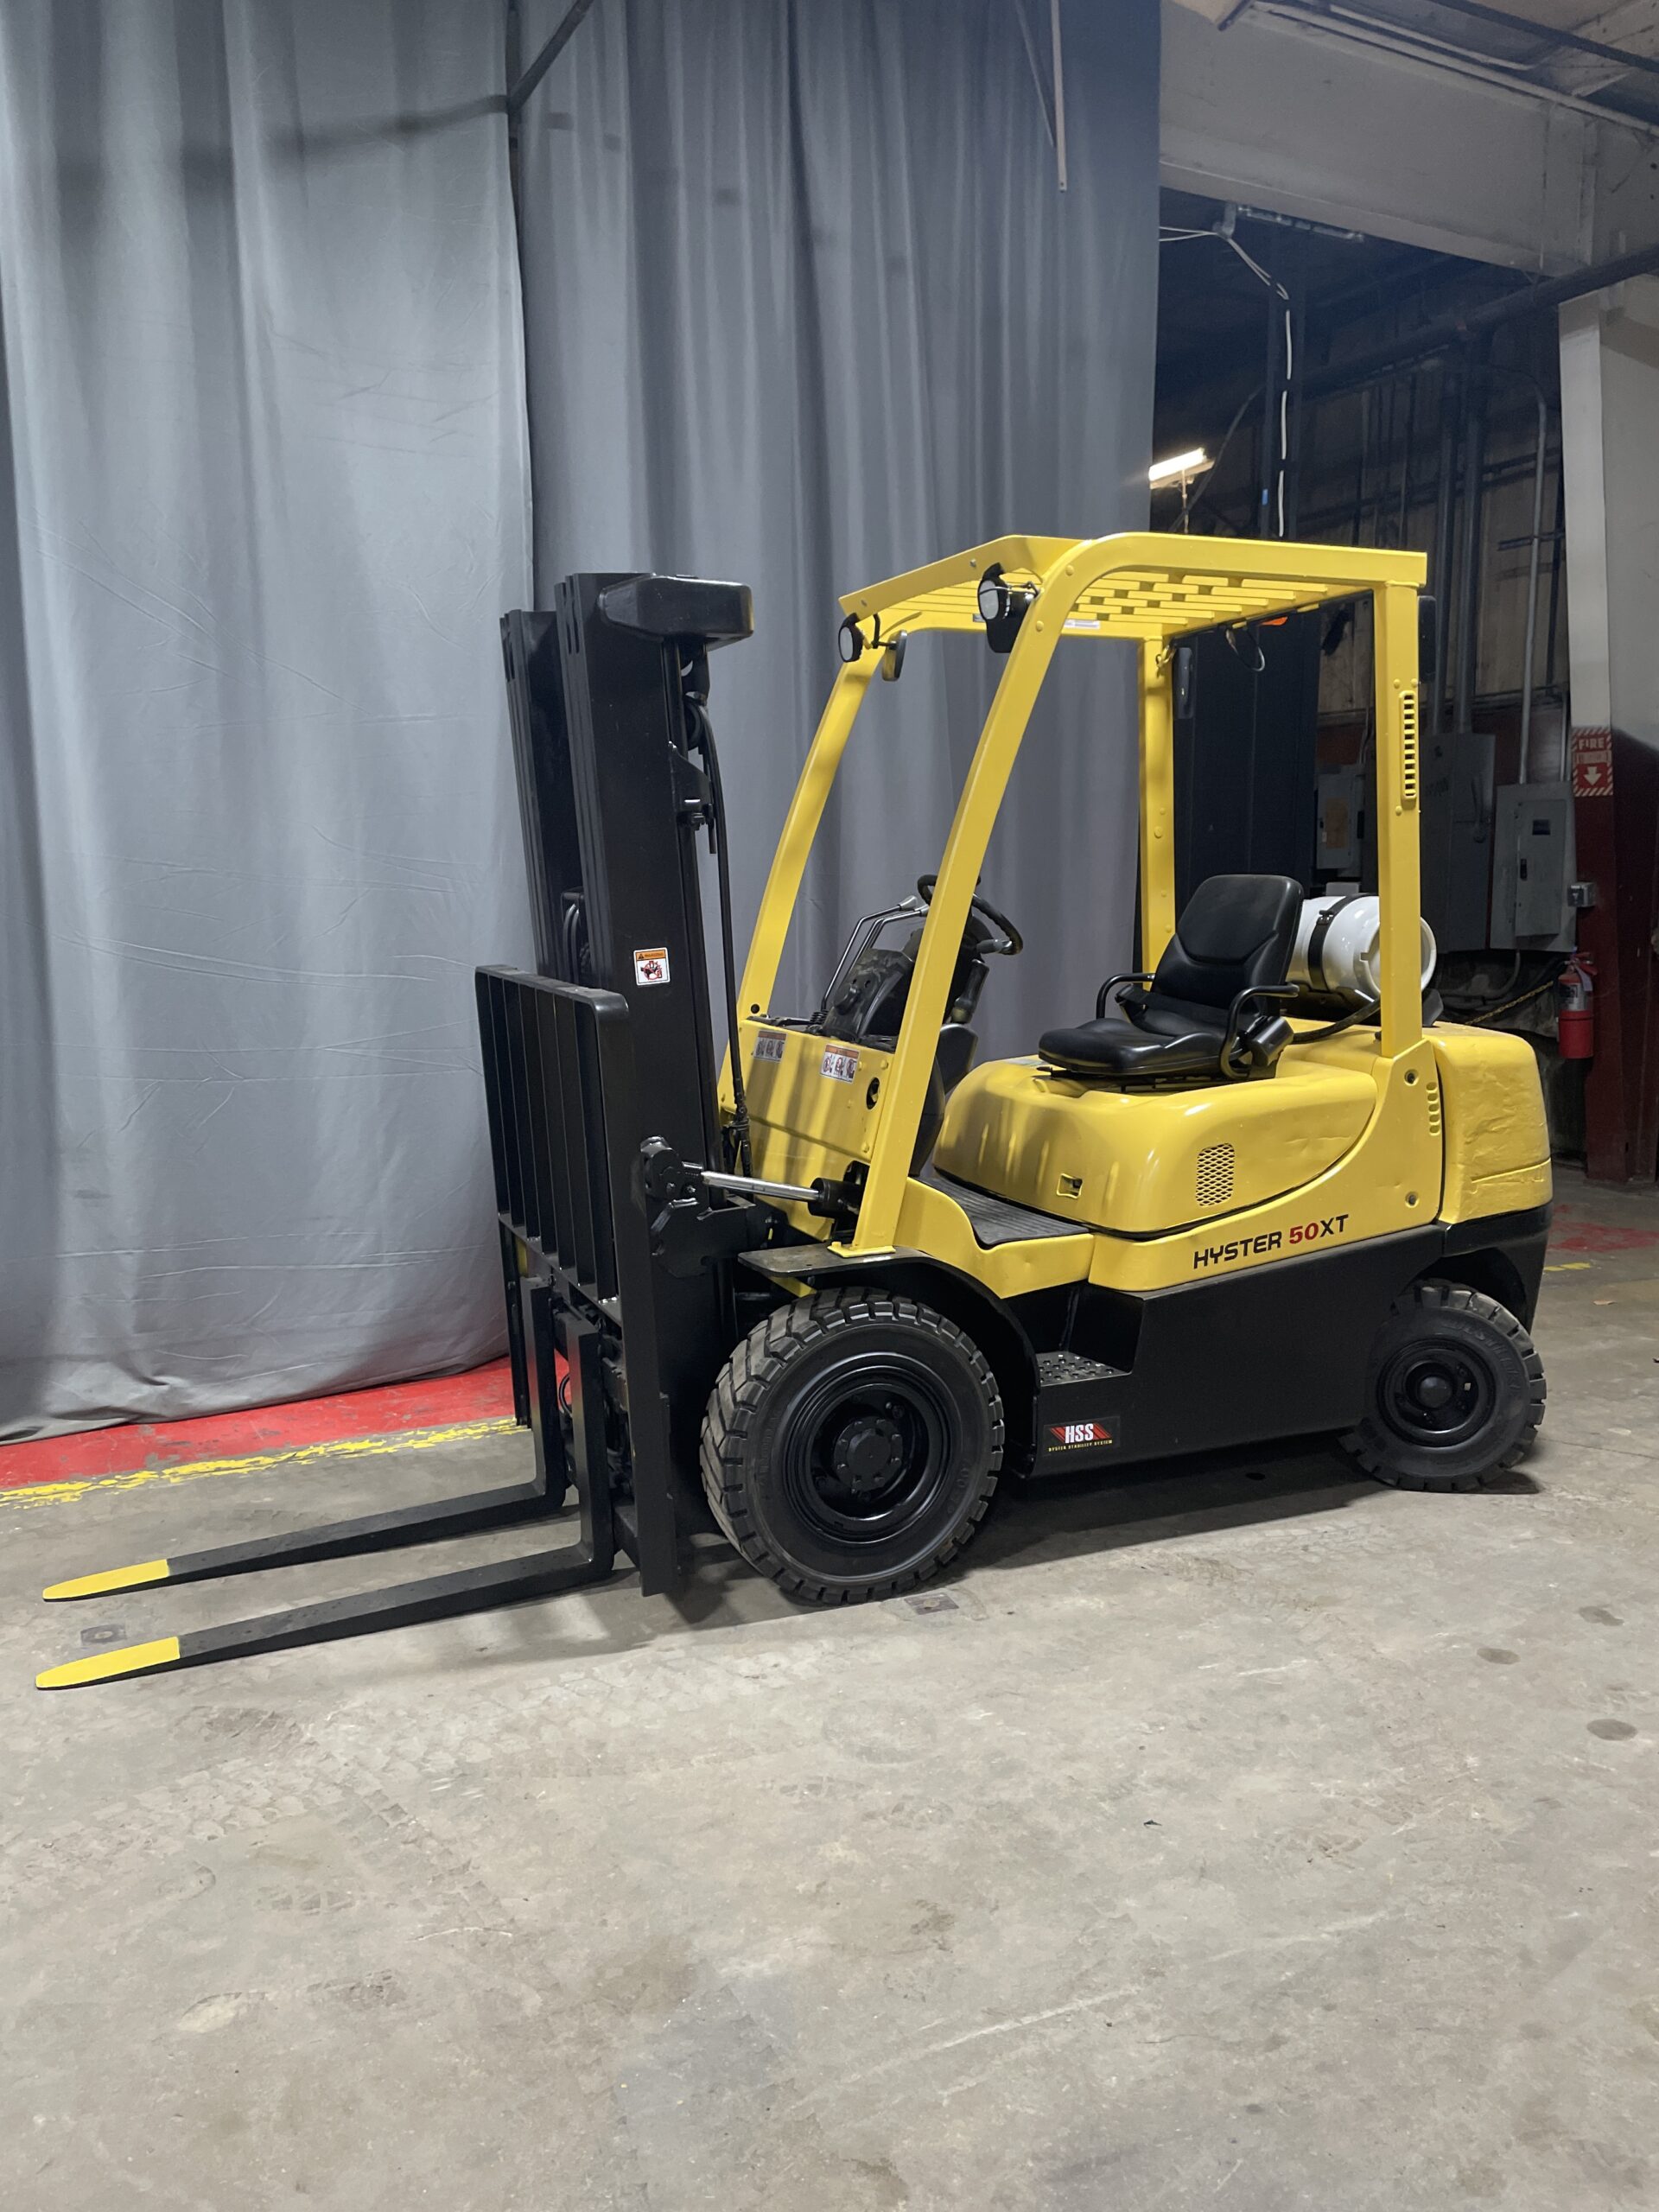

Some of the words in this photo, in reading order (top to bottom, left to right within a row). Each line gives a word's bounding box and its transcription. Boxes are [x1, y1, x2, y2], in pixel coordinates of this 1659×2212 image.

[1579, 737, 1605, 750] FIRE
[1193, 1231, 1282, 1269] HYSTER
[1289, 1214, 1349, 1244] 50XT
[1065, 1423, 1094, 1444] HSS
